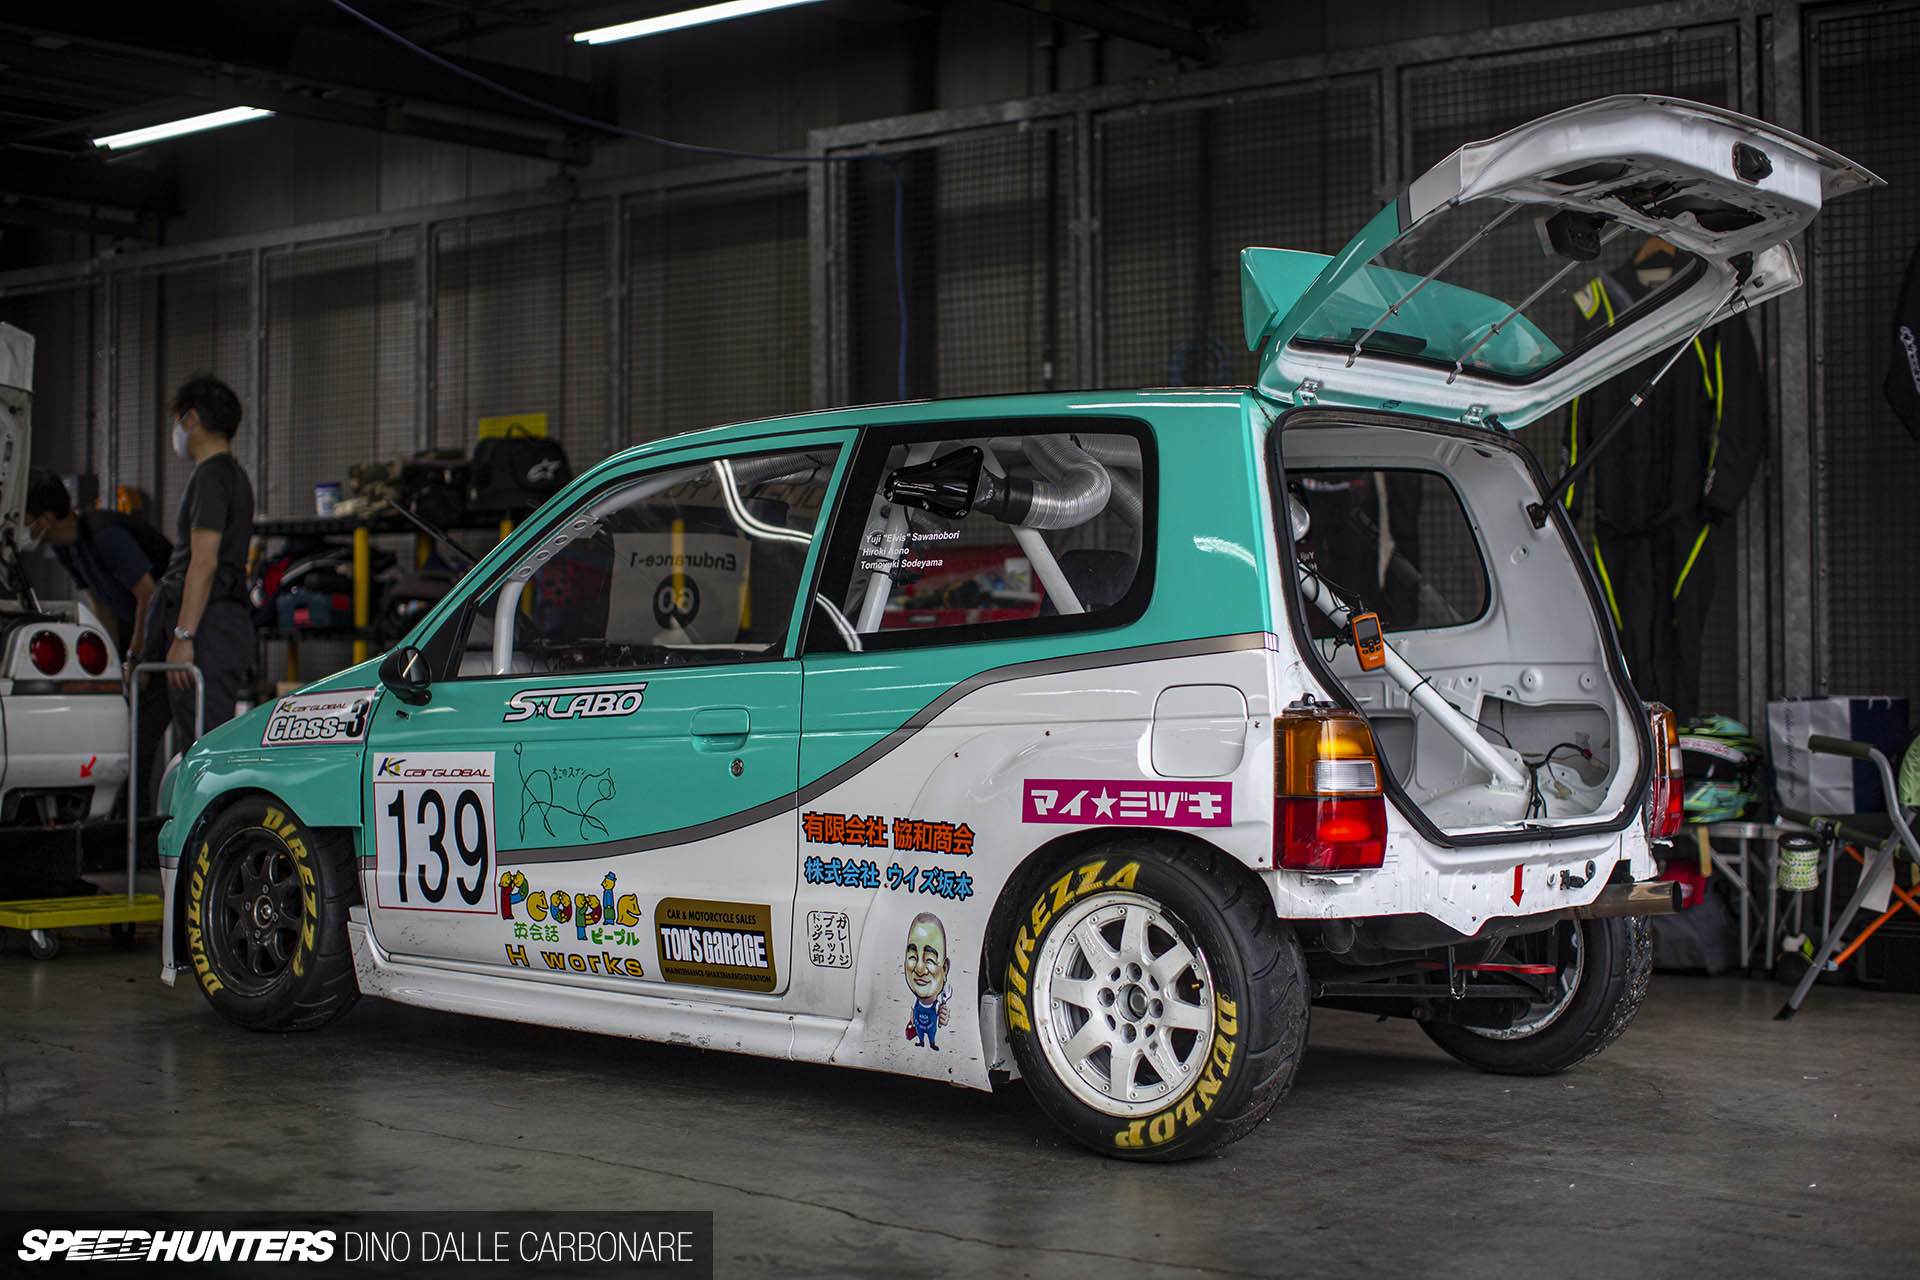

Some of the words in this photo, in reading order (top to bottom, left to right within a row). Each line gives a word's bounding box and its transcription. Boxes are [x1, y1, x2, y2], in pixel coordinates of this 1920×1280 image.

[862, 547, 887, 557] Hiroki
[912, 530, 960, 542] Sawanobori
[901, 558, 943, 569] Sodeyama
[267, 699, 370, 742] Class-3
[387, 788, 489, 906] 139
[802, 811, 889, 848] 有限会社
[892, 817, 976, 857] 協和商会
[262, 807, 318, 977] DIREZZA
[804, 856, 881, 888] 株式会社
[887, 862, 974, 901] ウイズ坂本
[187, 841, 224, 996] DUNLOP
[498, 870, 643, 941] People
[666, 909, 681, 921] CAR
[688, 910, 735, 924] MOTORCYCLE
[735, 914, 757, 925] SALES
[513, 921, 560, 943] 英会話
[591, 928, 640, 946] ピープル
[660, 926, 703, 963] TOM'S
[1005, 861, 1141, 1032] DIREZZA
[505, 943, 531, 968] H
[539, 951, 644, 977] works
[1115, 992, 1238, 1148] DUNLOP
